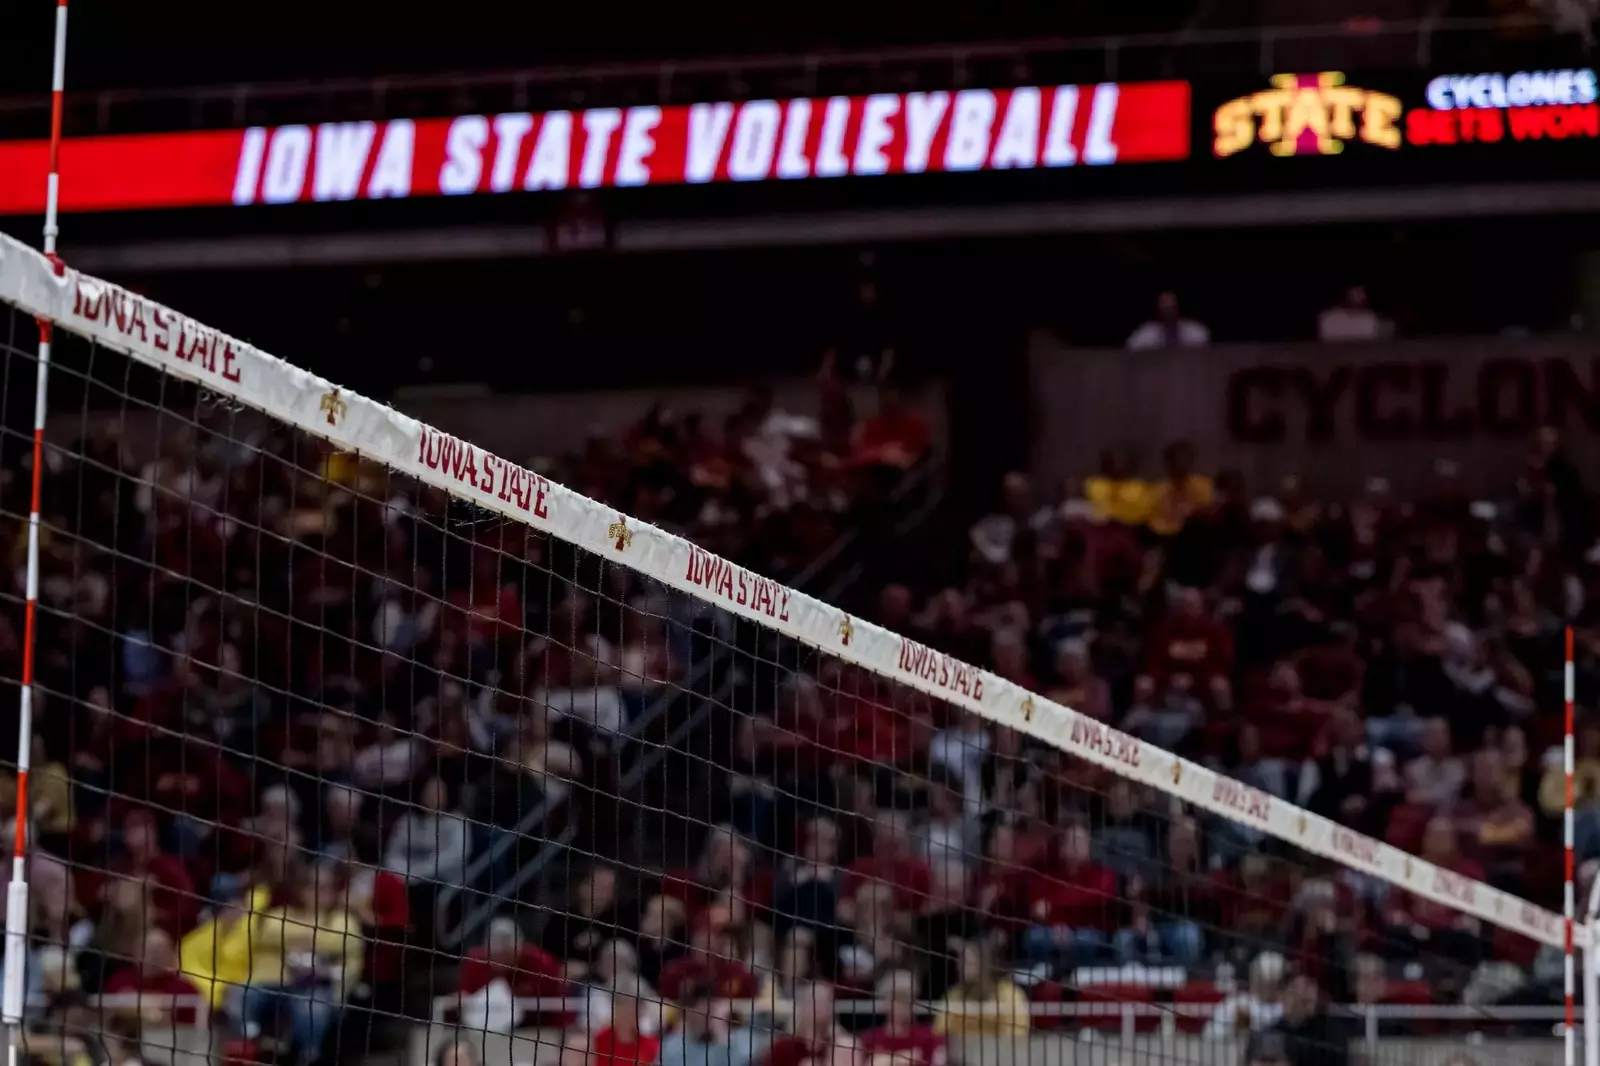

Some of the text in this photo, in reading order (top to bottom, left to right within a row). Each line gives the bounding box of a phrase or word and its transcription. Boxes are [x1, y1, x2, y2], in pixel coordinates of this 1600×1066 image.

[1212, 84, 1401, 159] STATE
[1406, 107, 1502, 146] SETS
[1425, 68, 1598, 110] CYCLONES
[232, 82, 1119, 206] IOWA STATE VOLLEYBALL
[73, 273, 241, 383] IOWA STATE
[418, 424, 550, 519] IOWA STATE
[686, 543, 791, 622] IOWA STATE
[899, 637, 937, 682] IOWA
